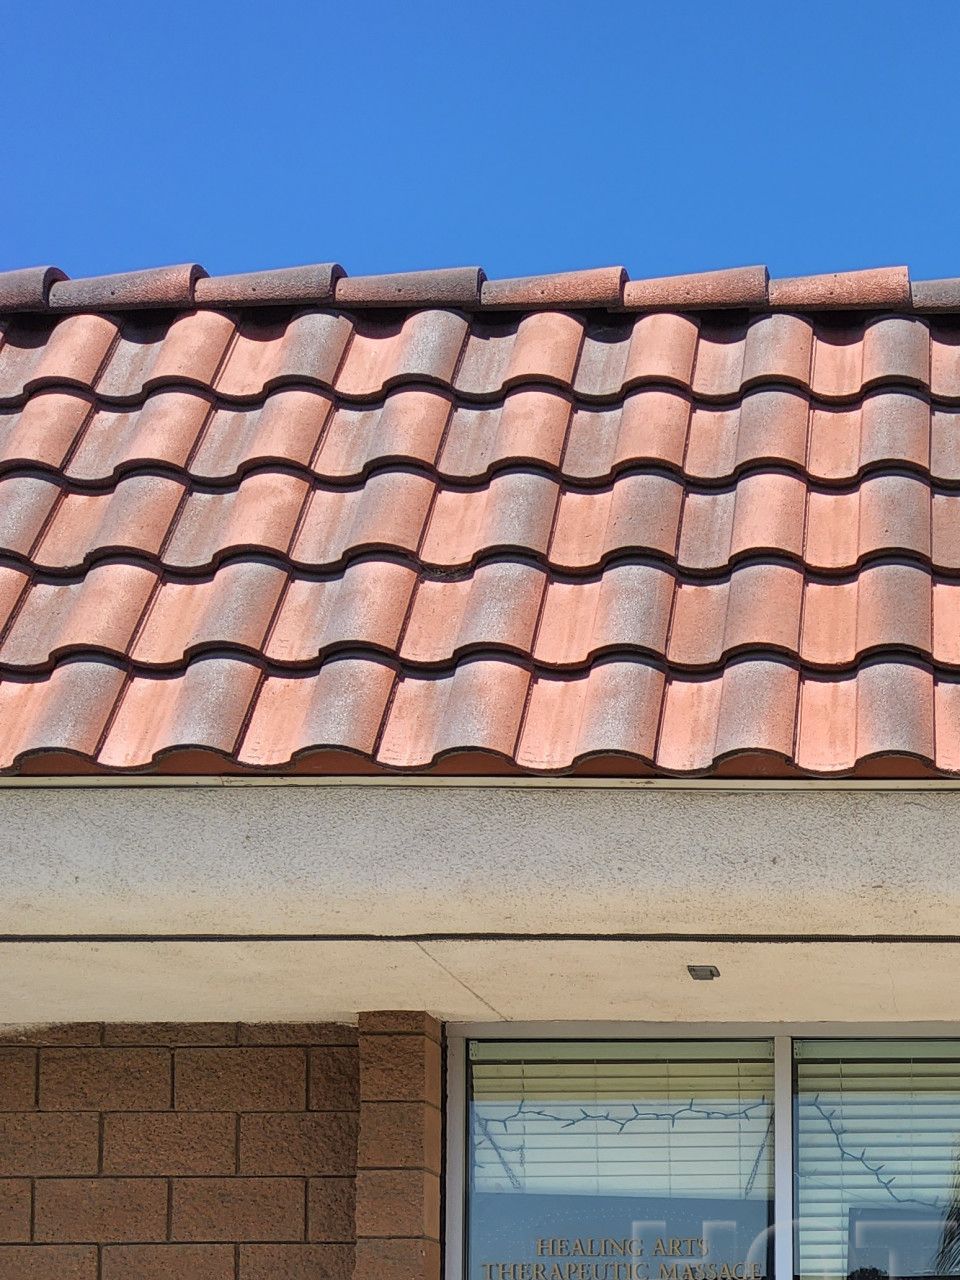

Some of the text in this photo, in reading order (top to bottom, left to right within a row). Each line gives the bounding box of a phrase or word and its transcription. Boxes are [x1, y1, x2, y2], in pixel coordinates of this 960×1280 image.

[536, 1238, 709, 1257] HEALING ARTS
[659, 1262, 763, 1280] MASSAGE
